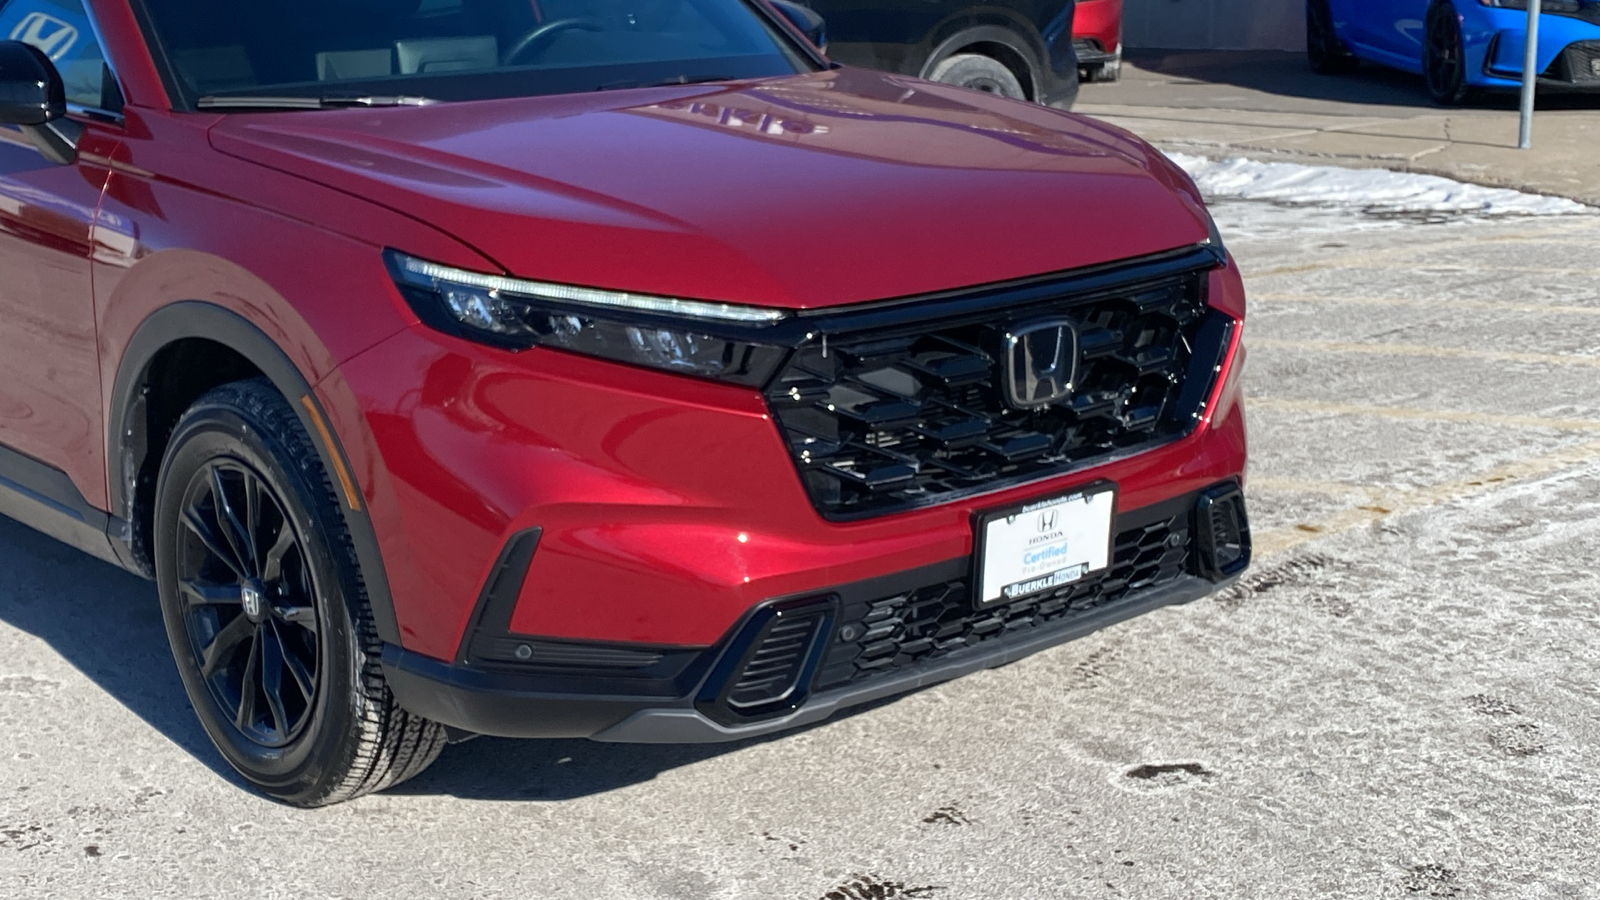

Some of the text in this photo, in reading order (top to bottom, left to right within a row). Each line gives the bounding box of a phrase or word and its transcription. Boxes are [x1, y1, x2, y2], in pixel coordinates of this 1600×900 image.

[1028, 530, 1063, 545] HONDA
[1023, 542, 1067, 565] Certified
[1011, 575, 1054, 596] BUERKLE
